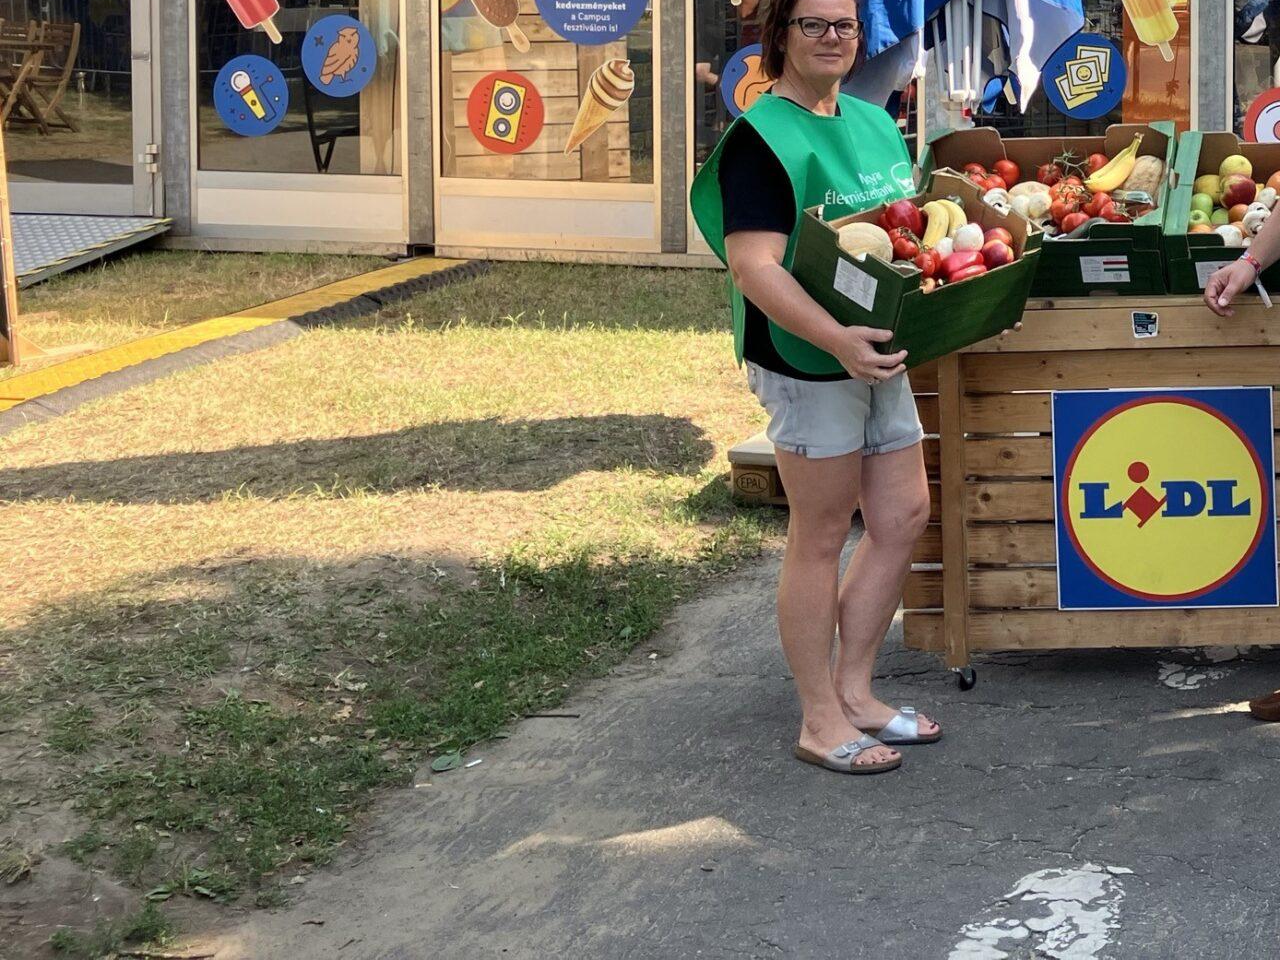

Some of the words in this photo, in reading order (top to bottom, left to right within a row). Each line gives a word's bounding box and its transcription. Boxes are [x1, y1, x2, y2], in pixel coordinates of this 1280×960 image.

[555, 1, 626, 12] kedvezményeket
[577, 12, 611, 23] Campus
[563, 23, 607, 32] fesztiválon
[608, 24, 618, 32] is!
[740, 476, 764, 490] EPAL
